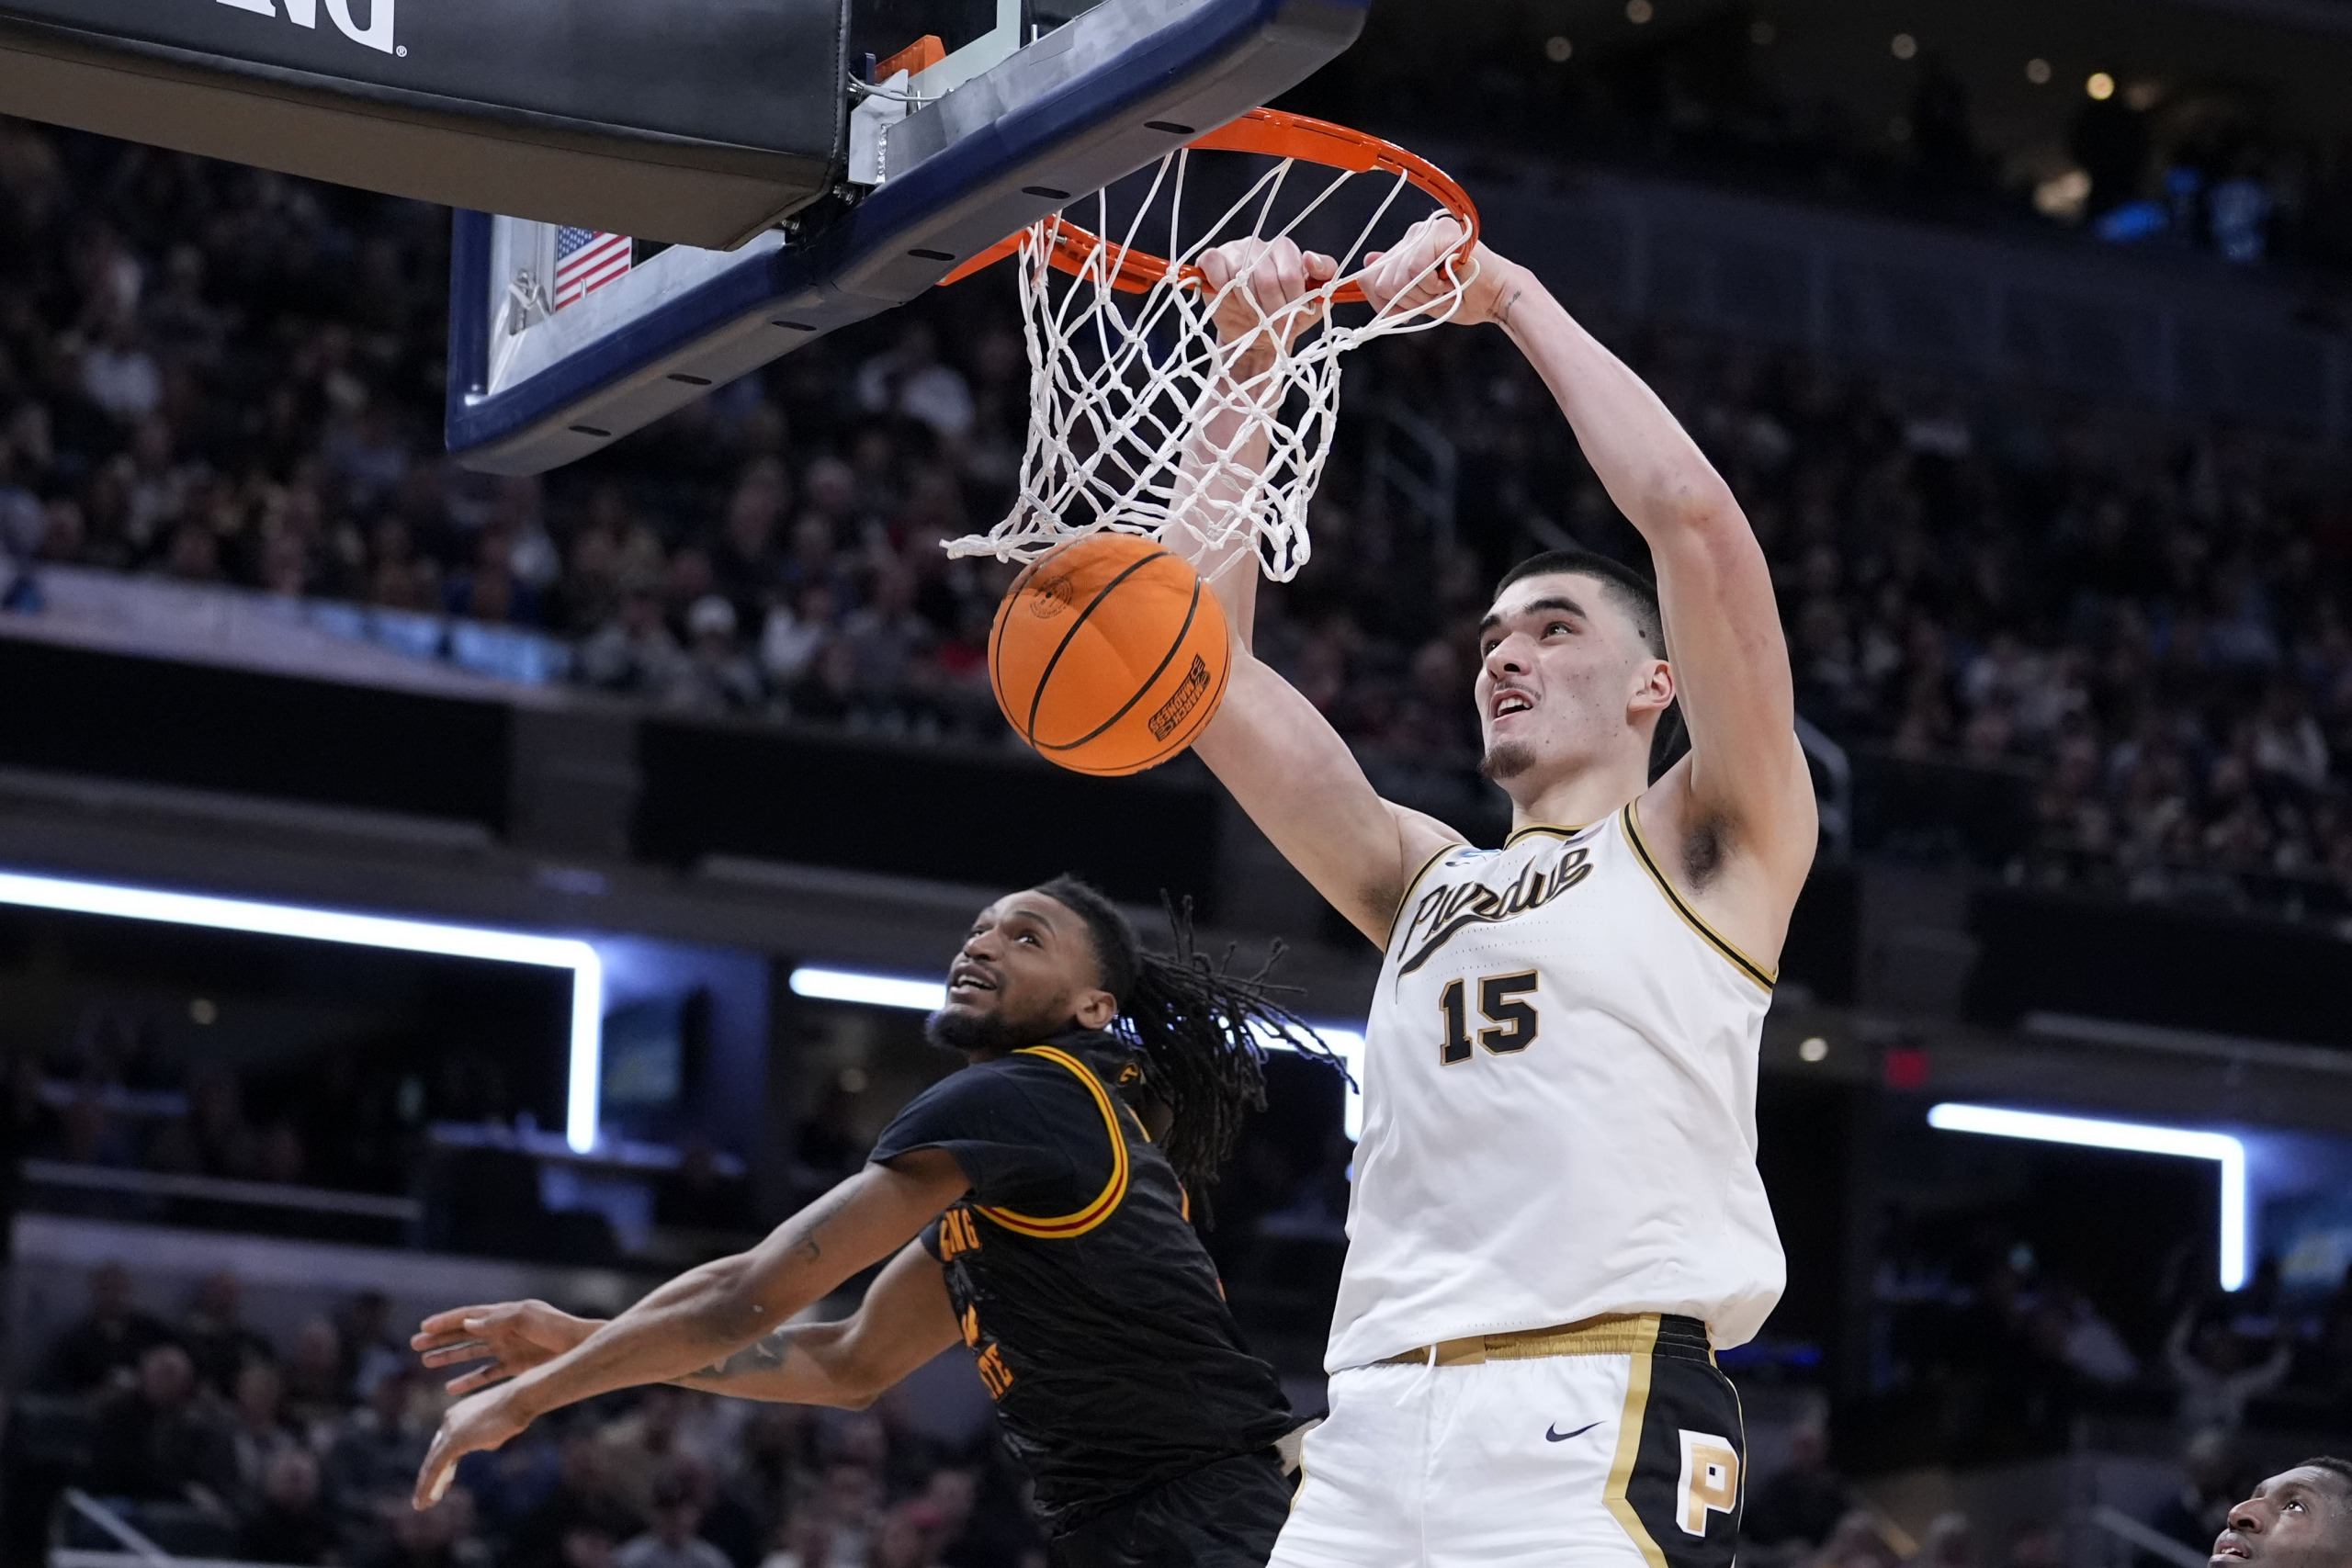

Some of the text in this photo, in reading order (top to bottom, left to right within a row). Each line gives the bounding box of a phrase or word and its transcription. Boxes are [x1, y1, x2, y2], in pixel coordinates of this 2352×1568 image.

[1149, 678, 1198, 733] MADNESS
[1170, 682, 1204, 725] MARCH
[1396, 847, 1594, 976] Purdue
[1439, 969, 1539, 1066] 15
[1676, 1428, 1740, 1538] P
